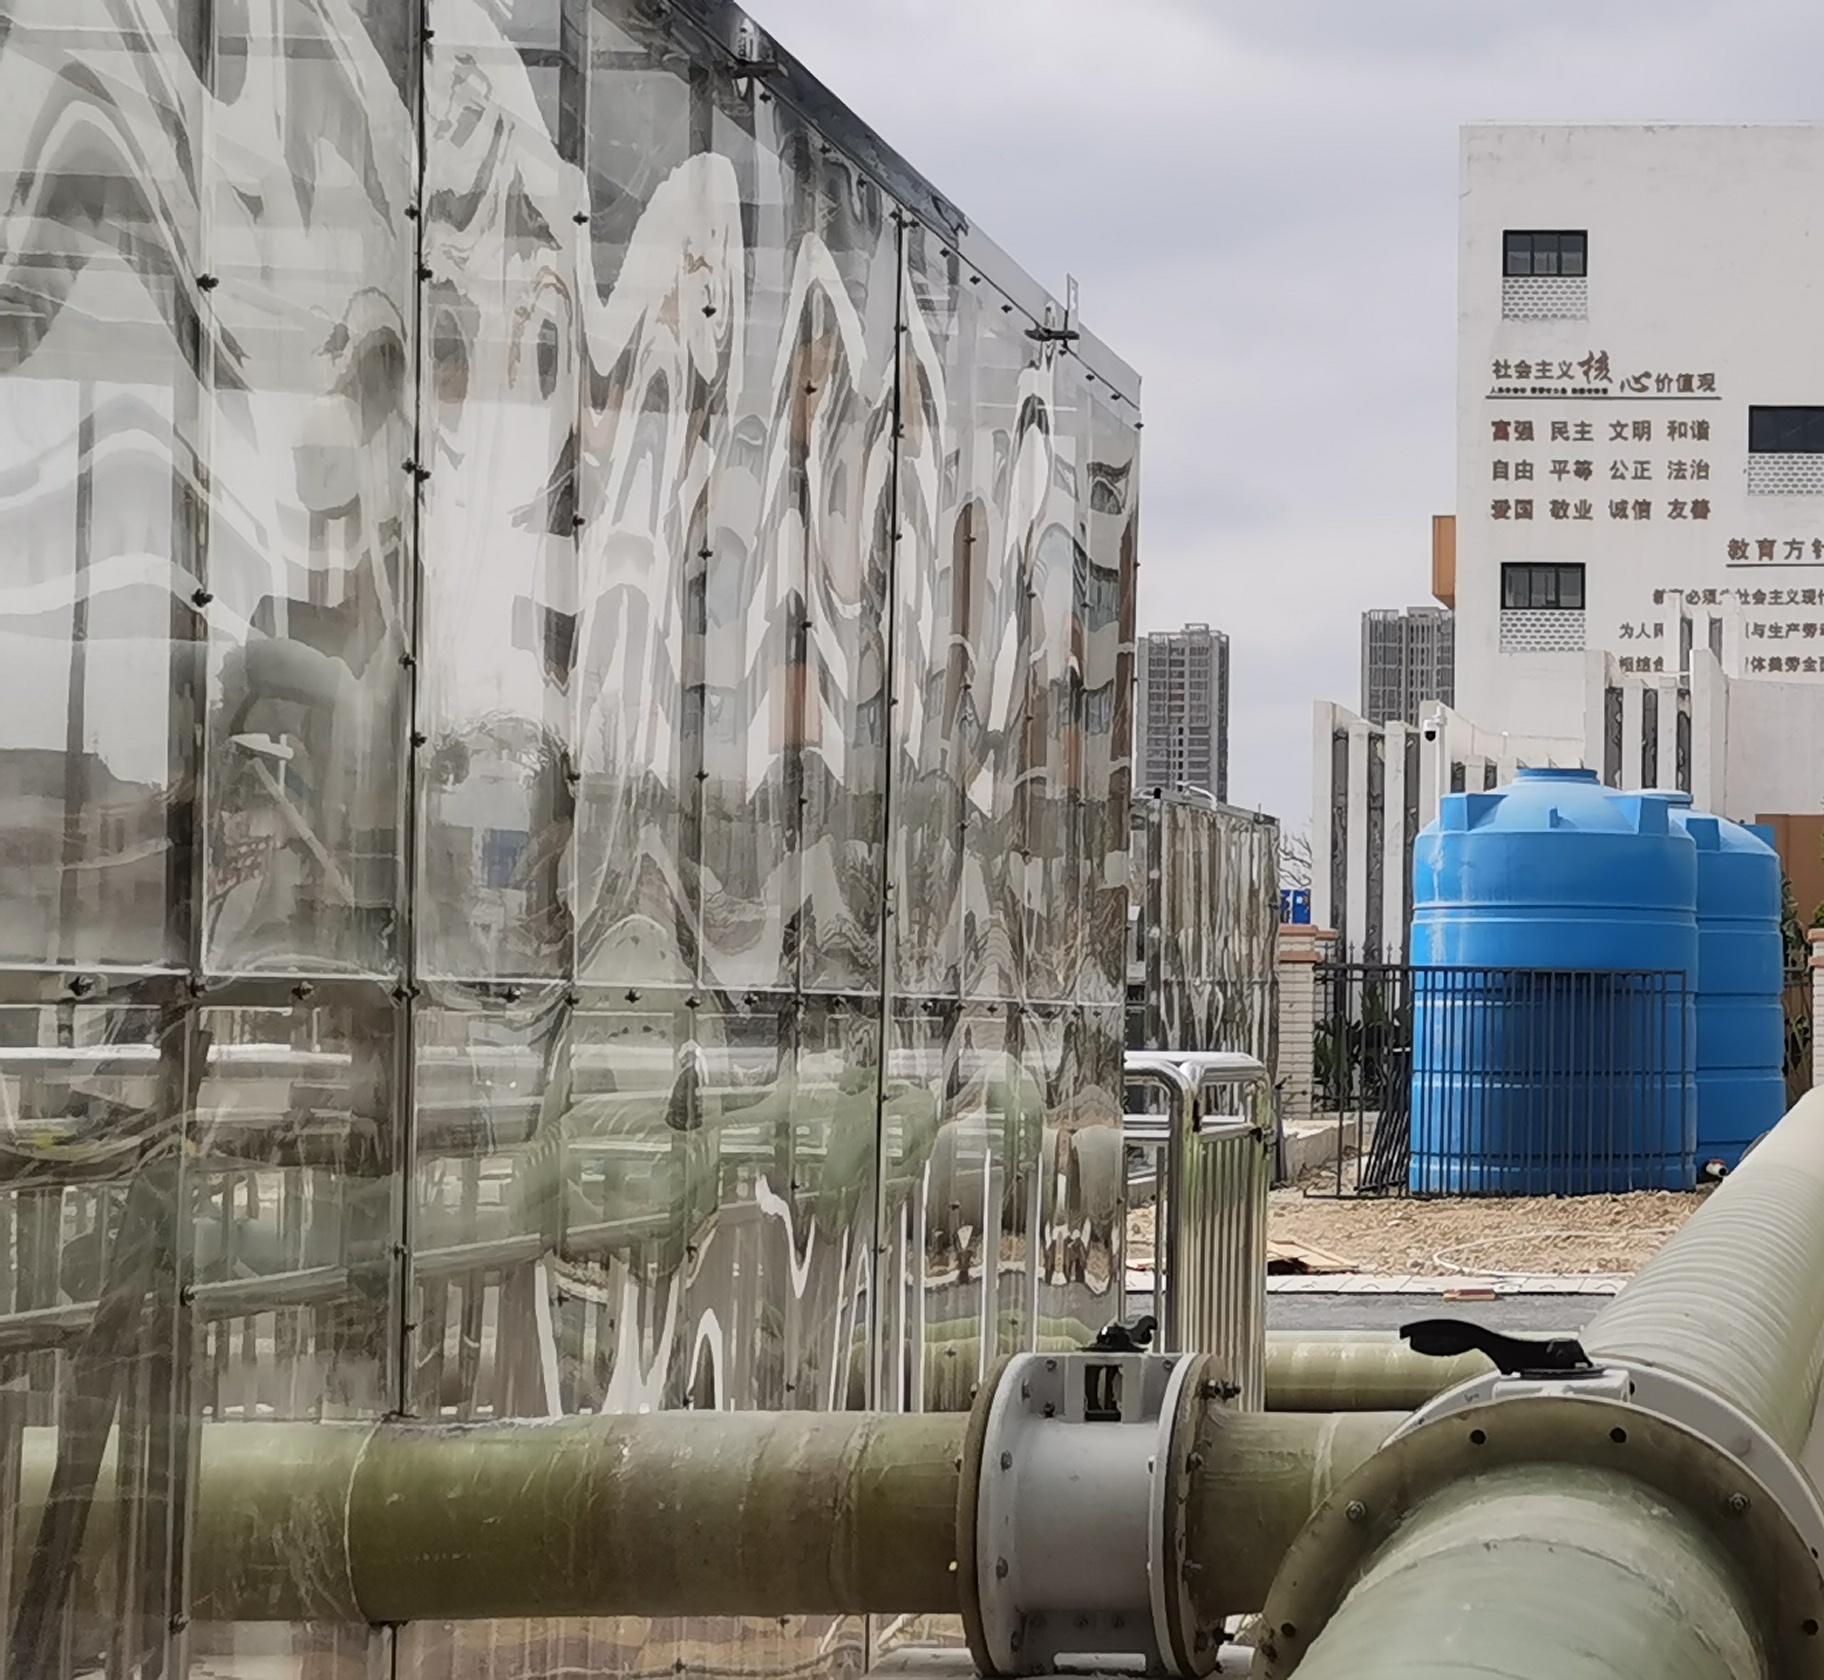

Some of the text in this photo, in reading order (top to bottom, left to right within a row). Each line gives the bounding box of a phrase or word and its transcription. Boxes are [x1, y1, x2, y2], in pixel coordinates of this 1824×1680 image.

[1491, 350, 1716, 393] 社会主义核心价值观
[1491, 419, 1710, 441] 富强 民主 文明 和谐
[1491, 459, 1710, 481] 自由 平等 公正 法治
[1491, 499, 1710, 520] 爱国 敬业 诚信 友善
